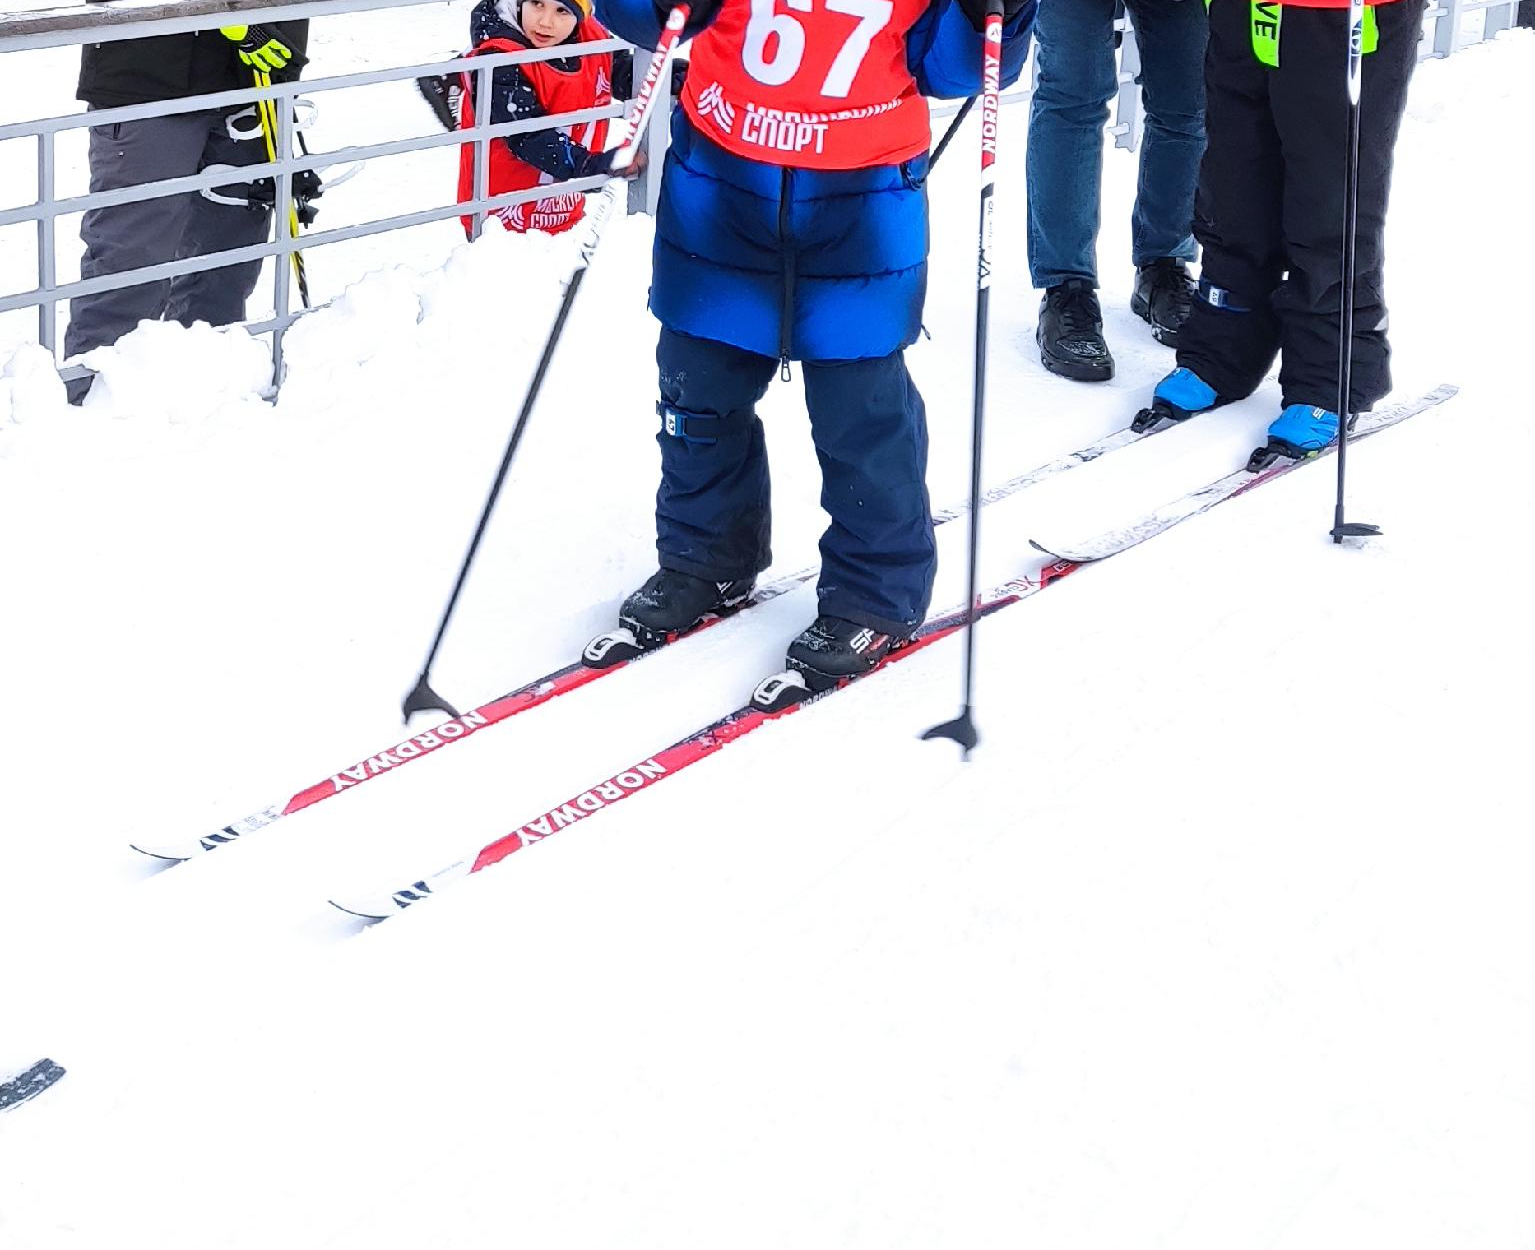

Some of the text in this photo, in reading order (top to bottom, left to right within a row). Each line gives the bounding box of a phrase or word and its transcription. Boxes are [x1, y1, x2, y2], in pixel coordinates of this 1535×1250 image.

[741, 112, 828, 154] СПОРТ
[983, 55, 1000, 153] NORDWAY
[329, 710, 488, 791] NORDWAY
[516, 759, 667, 846] NORDWAY
